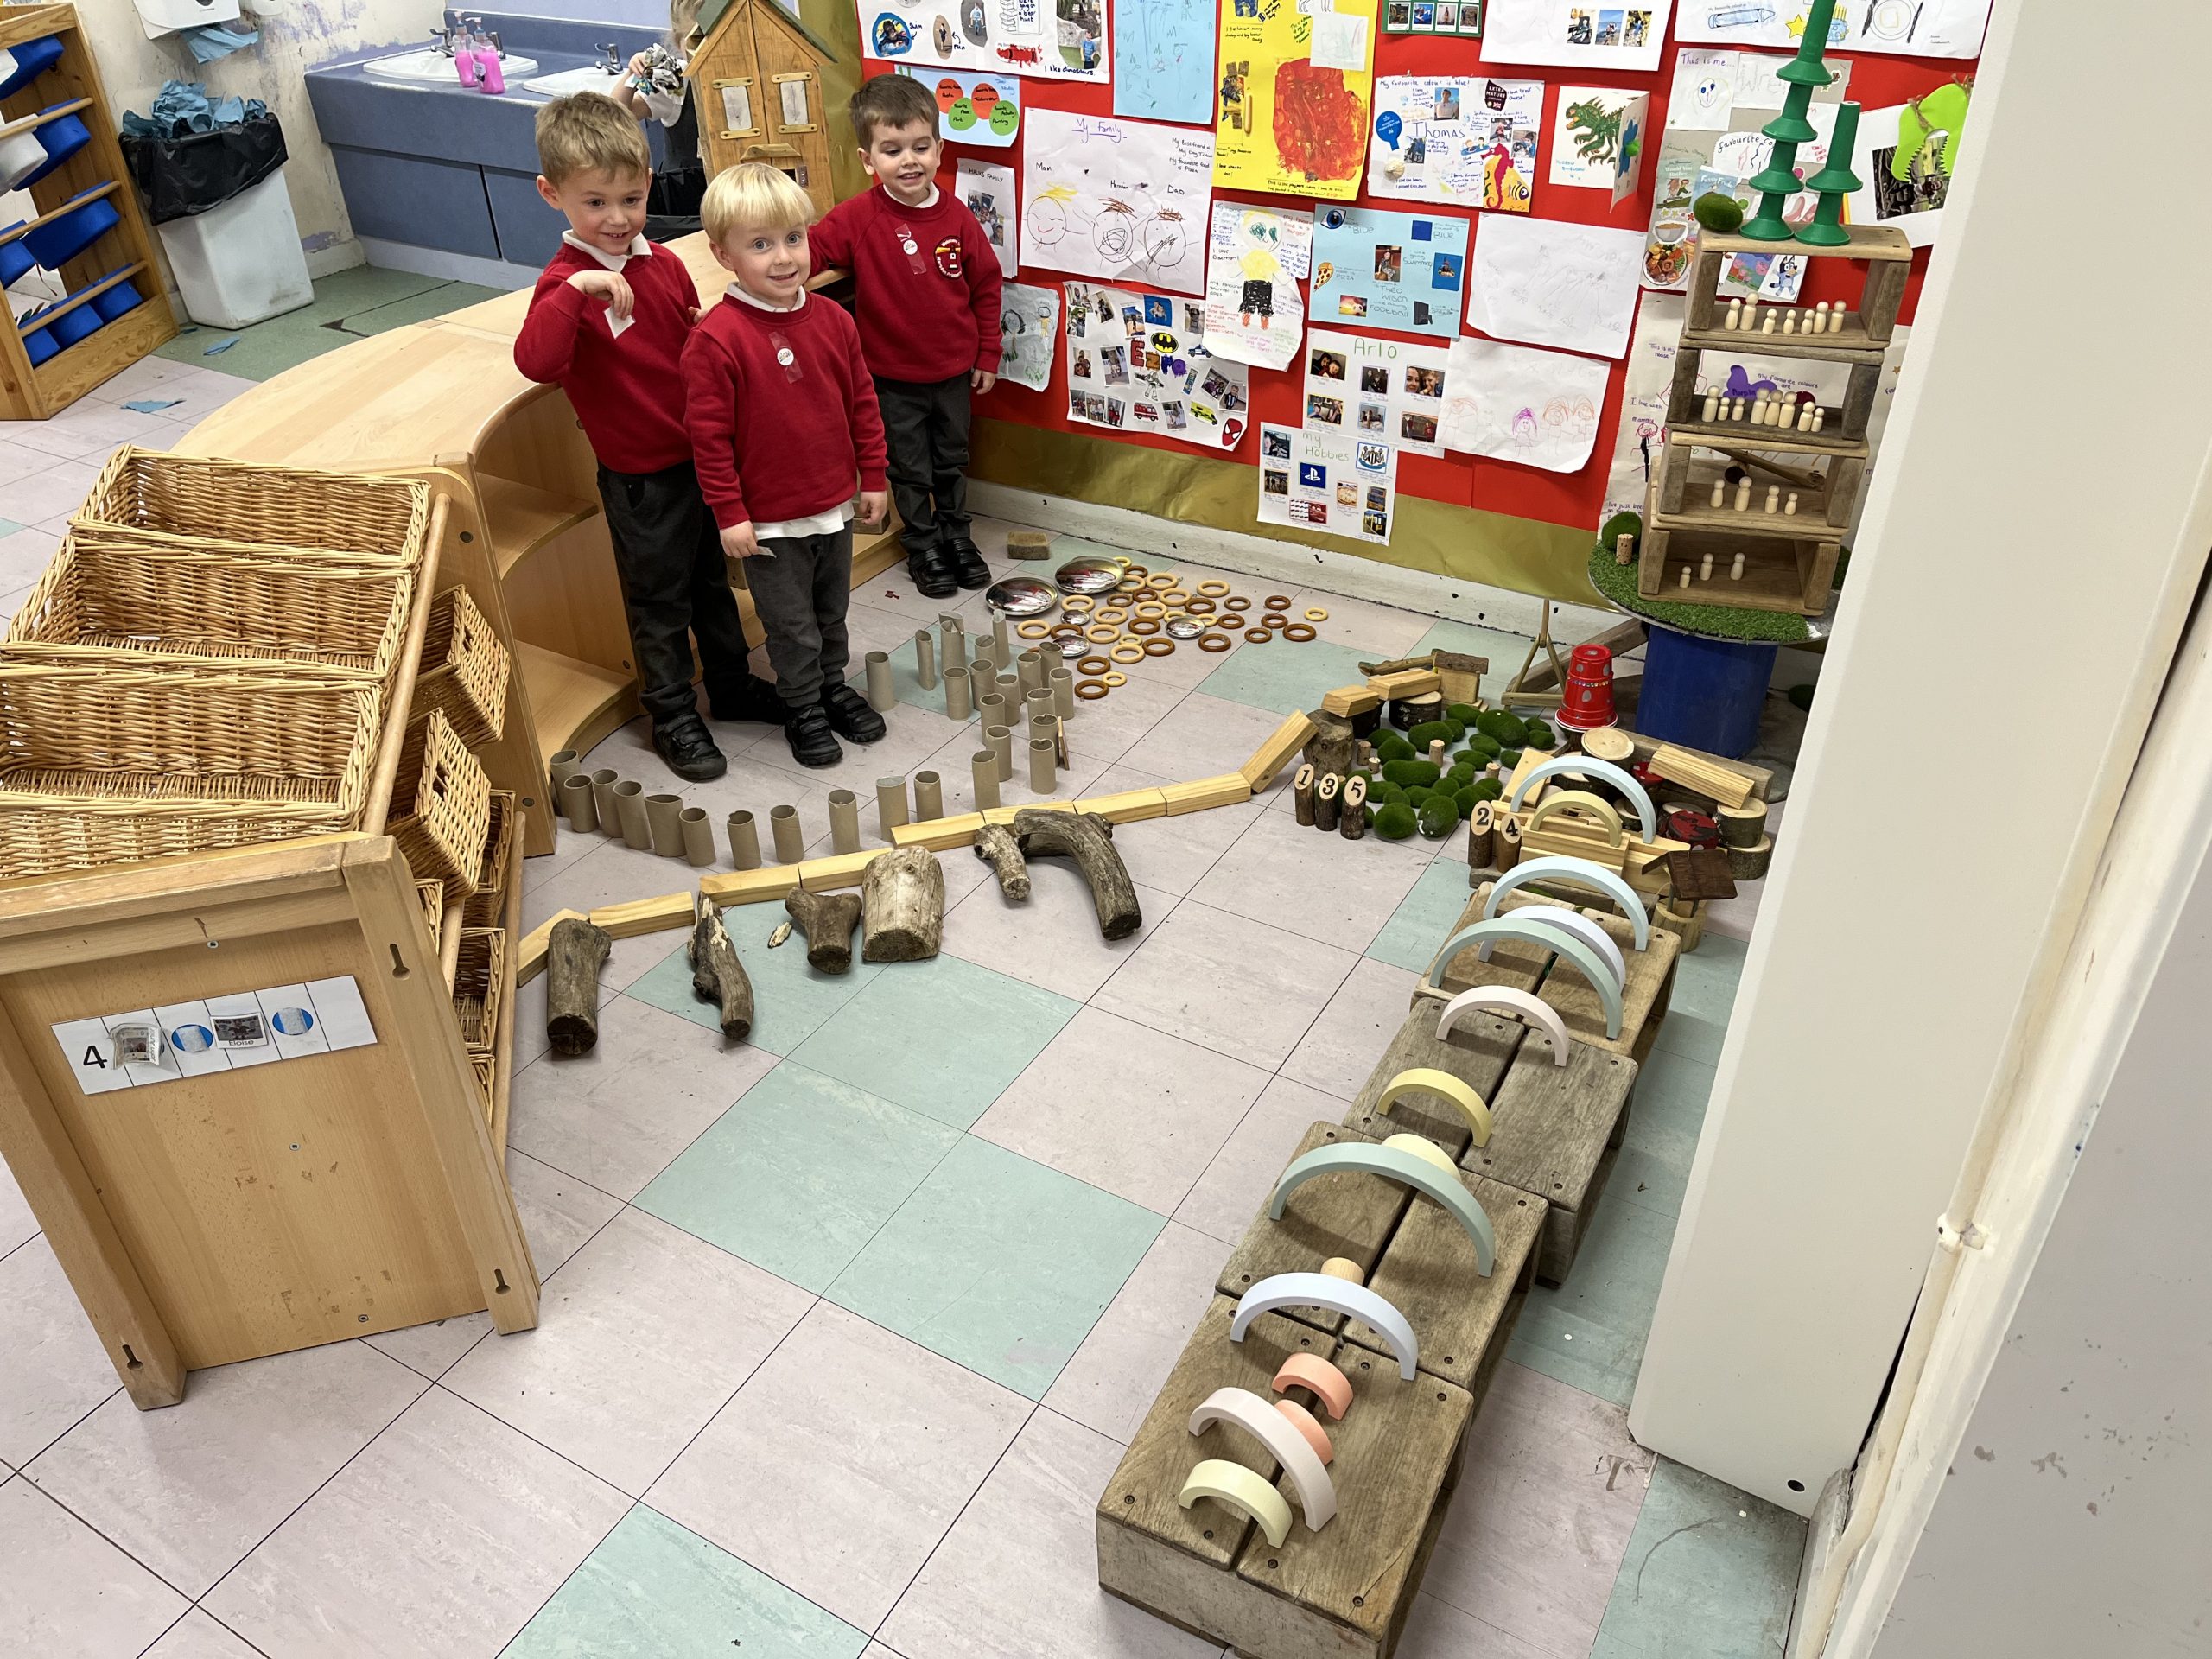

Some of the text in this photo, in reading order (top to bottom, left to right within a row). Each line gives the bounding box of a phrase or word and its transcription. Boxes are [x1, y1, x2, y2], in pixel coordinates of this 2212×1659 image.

[1681, 52, 1699, 66] This
[1076, 118, 1122, 143] My Family
[1353, 337, 1397, 359] Arlo
[1305, 445, 1350, 462] Hobbies
[1296, 768, 1310, 785] 1
[1322, 778, 1336, 795] 3
[1350, 782, 1363, 798] 5
[1475, 807, 1490, 825] 2
[1505, 821, 1519, 836] 4
[228, 1038, 255, 1046] Eloise
[82, 1045, 108, 1069] 4
